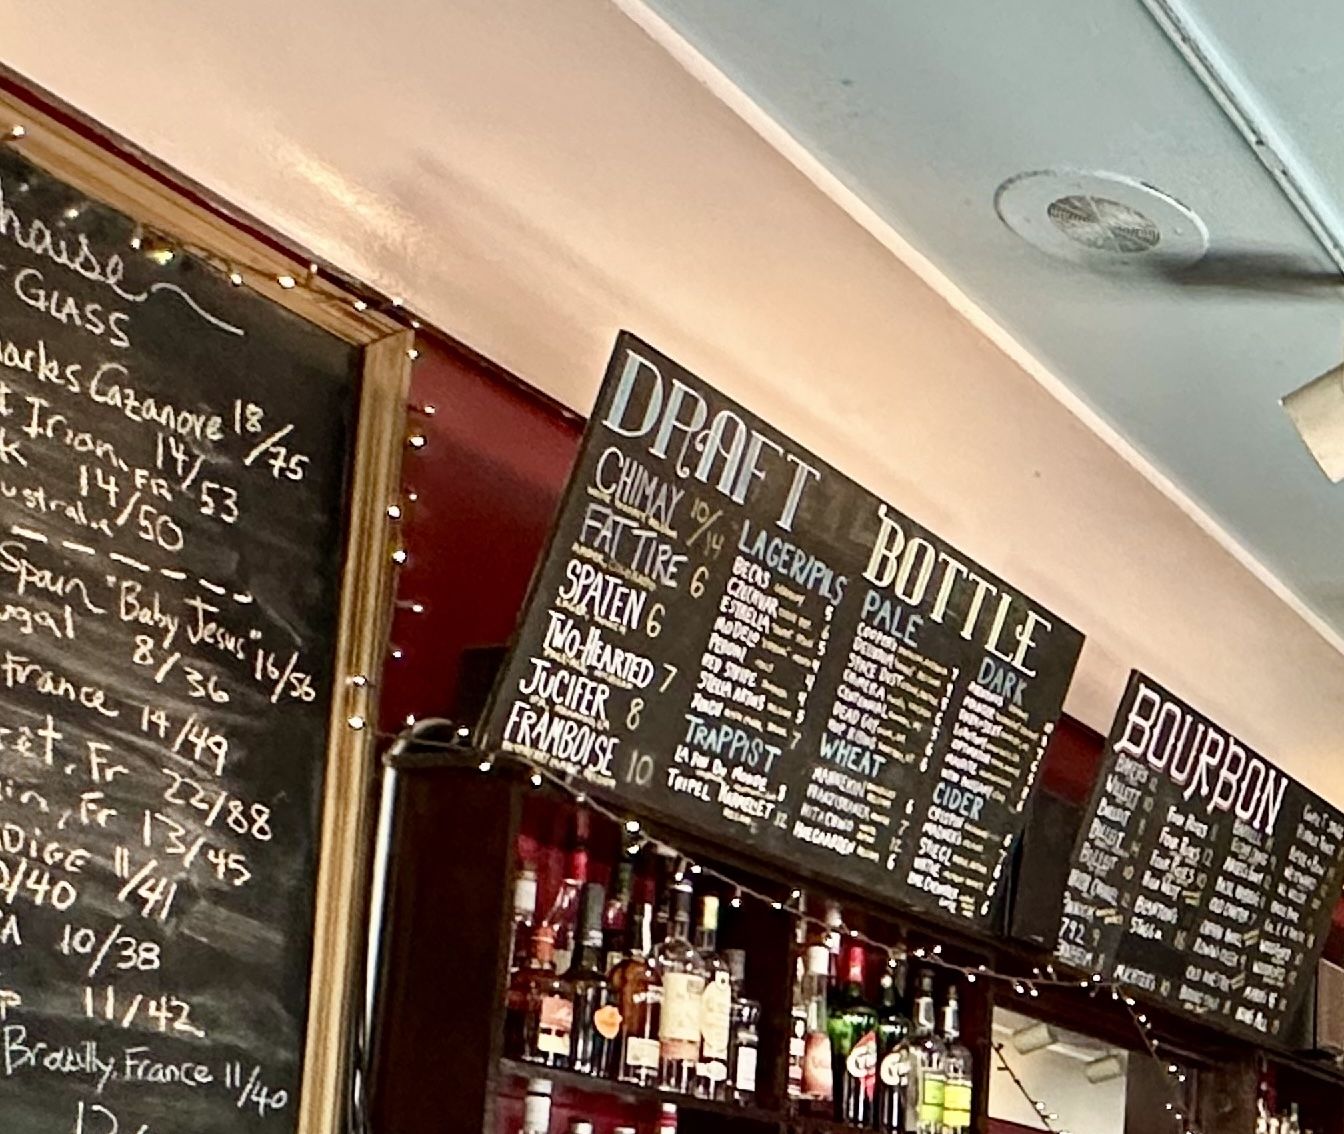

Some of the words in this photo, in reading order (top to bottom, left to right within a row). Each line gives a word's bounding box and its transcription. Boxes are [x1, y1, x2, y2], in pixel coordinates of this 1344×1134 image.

[14, 268, 130, 348] GLASS
[156, 432, 239, 524] 14/53
[235, 399, 310, 480] 18/75
[602, 349, 823, 532] DRAFT
[80, 465, 184, 551] 14/50
[596, 447, 685, 527] CHIMAY
[580, 503, 639, 561] FAT
[631, 528, 689, 588] TIRE
[690, 566, 709, 599] 6
[738, 518, 848, 606] LAGER/PILS
[558, 558, 648, 630] SPATEN
[646, 603, 665, 638] 6
[861, 589, 924, 648] PALE
[862, 504, 1052, 679] BOTTLE
[133, 634, 230, 703] 8/36
[255, 649, 315, 703] 16/56
[543, 610, 654, 688] TWO-HEARTED
[659, 663, 678, 693] 7
[977, 656, 1028, 706] DARK
[519, 657, 610, 721] JUCIFER
[626, 697, 645, 731] 8
[142, 706, 228, 777] 14/49
[504, 700, 620, 777] FRAMBOISE
[626, 749, 654, 785] 10
[684, 714, 782, 773] TRAPPIST
[820, 732, 887, 778] WHEAT
[1114, 683, 1288, 836] BOURBON
[87, 741, 129, 783] Fr
[162, 767, 272, 841] 22/88
[933, 782, 984, 820] CIDER
[80, 791, 118, 828] Fr
[143, 809, 251, 887] 13/45
[114, 846, 177, 921] 11/41
[60, 924, 161, 978] 10/38
[84, 985, 206, 1039] 11/42
[124, 1047, 214, 1084] France
[223, 1061, 288, 1118] 11/40
